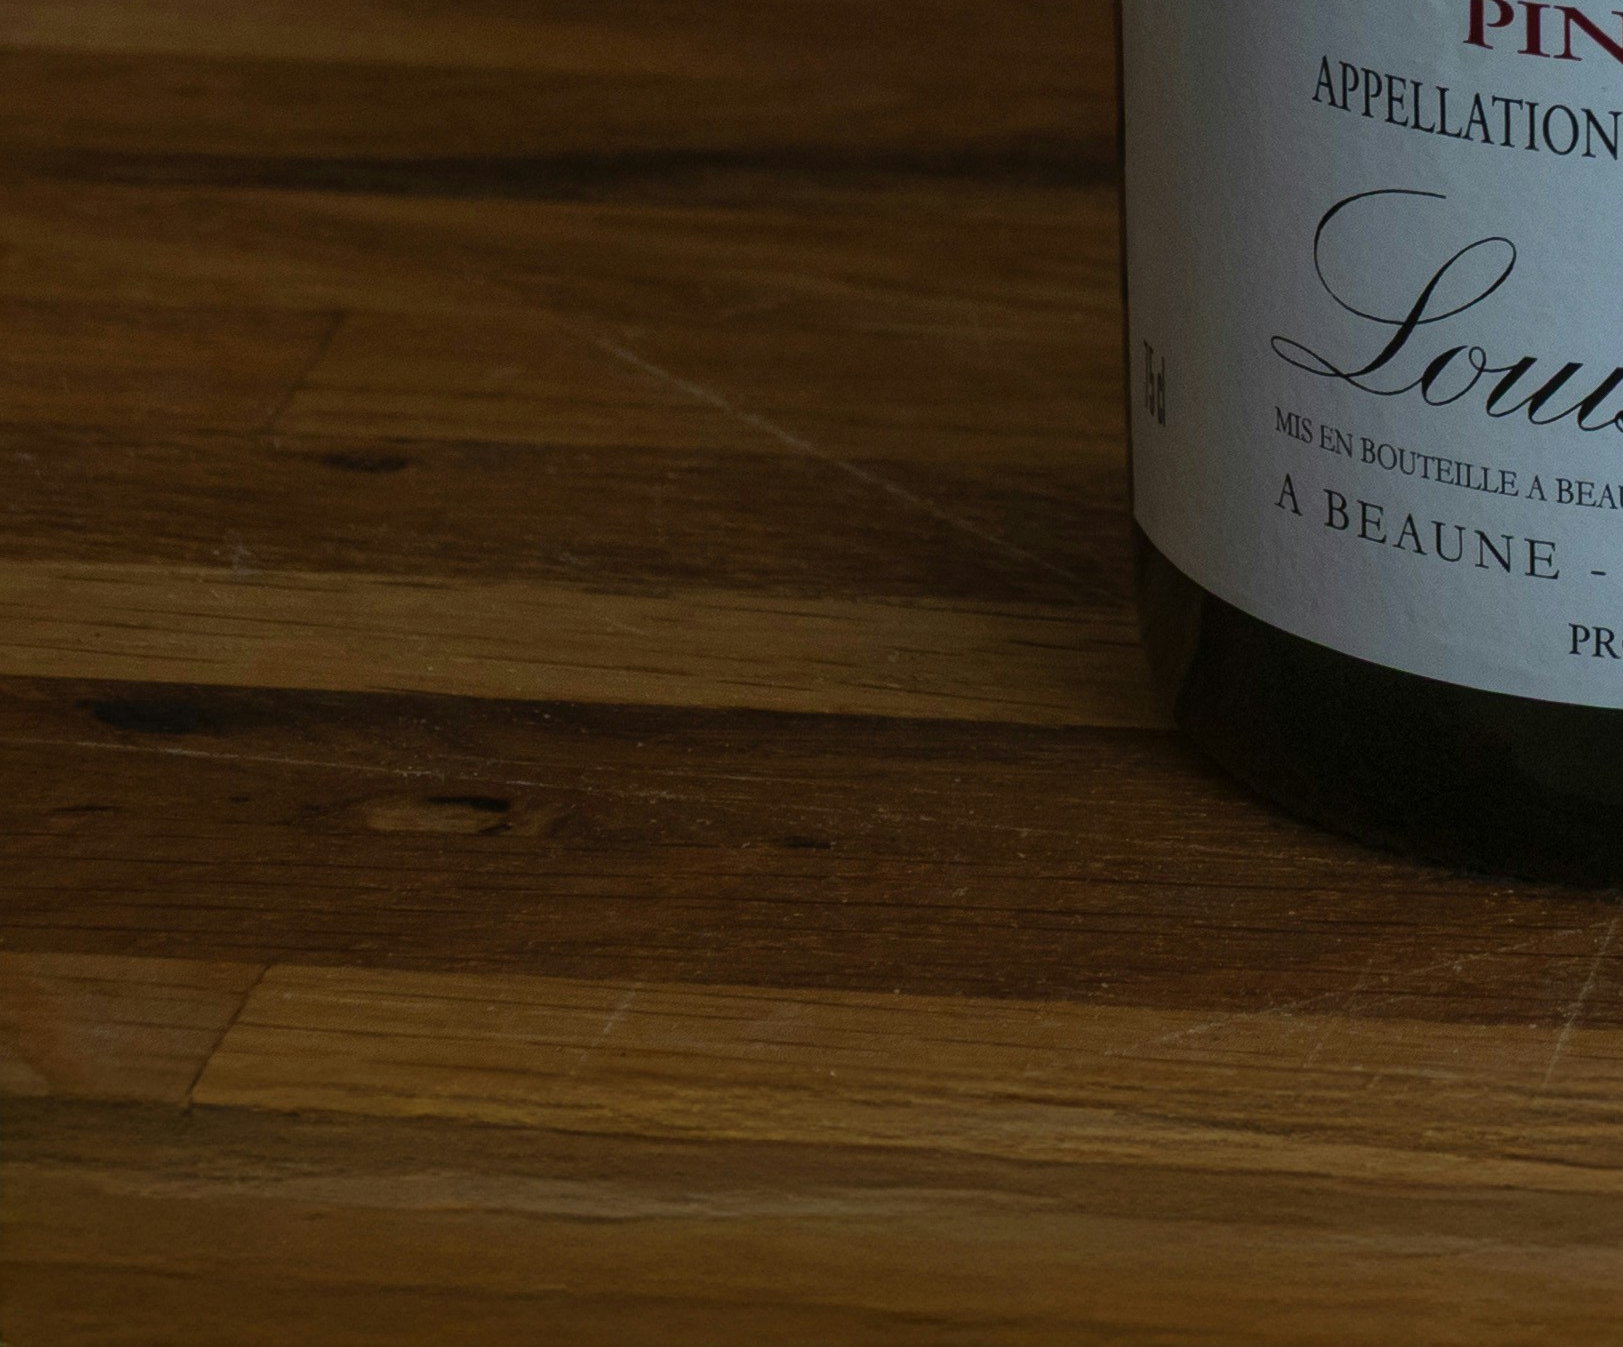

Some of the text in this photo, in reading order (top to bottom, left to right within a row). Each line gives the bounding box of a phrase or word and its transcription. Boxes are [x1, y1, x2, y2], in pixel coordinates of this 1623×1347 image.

[1311, 55, 1623, 161] APPELLATION
[1275, 405, 1313, 444] MIS
[1319, 424, 1353, 458] EN
[1360, 436, 1519, 497] BOUTEILLE
[1525, 475, 1547, 502] A
[1274, 473, 1303, 517] A
[1323, 487, 1562, 582] BEAUNE
